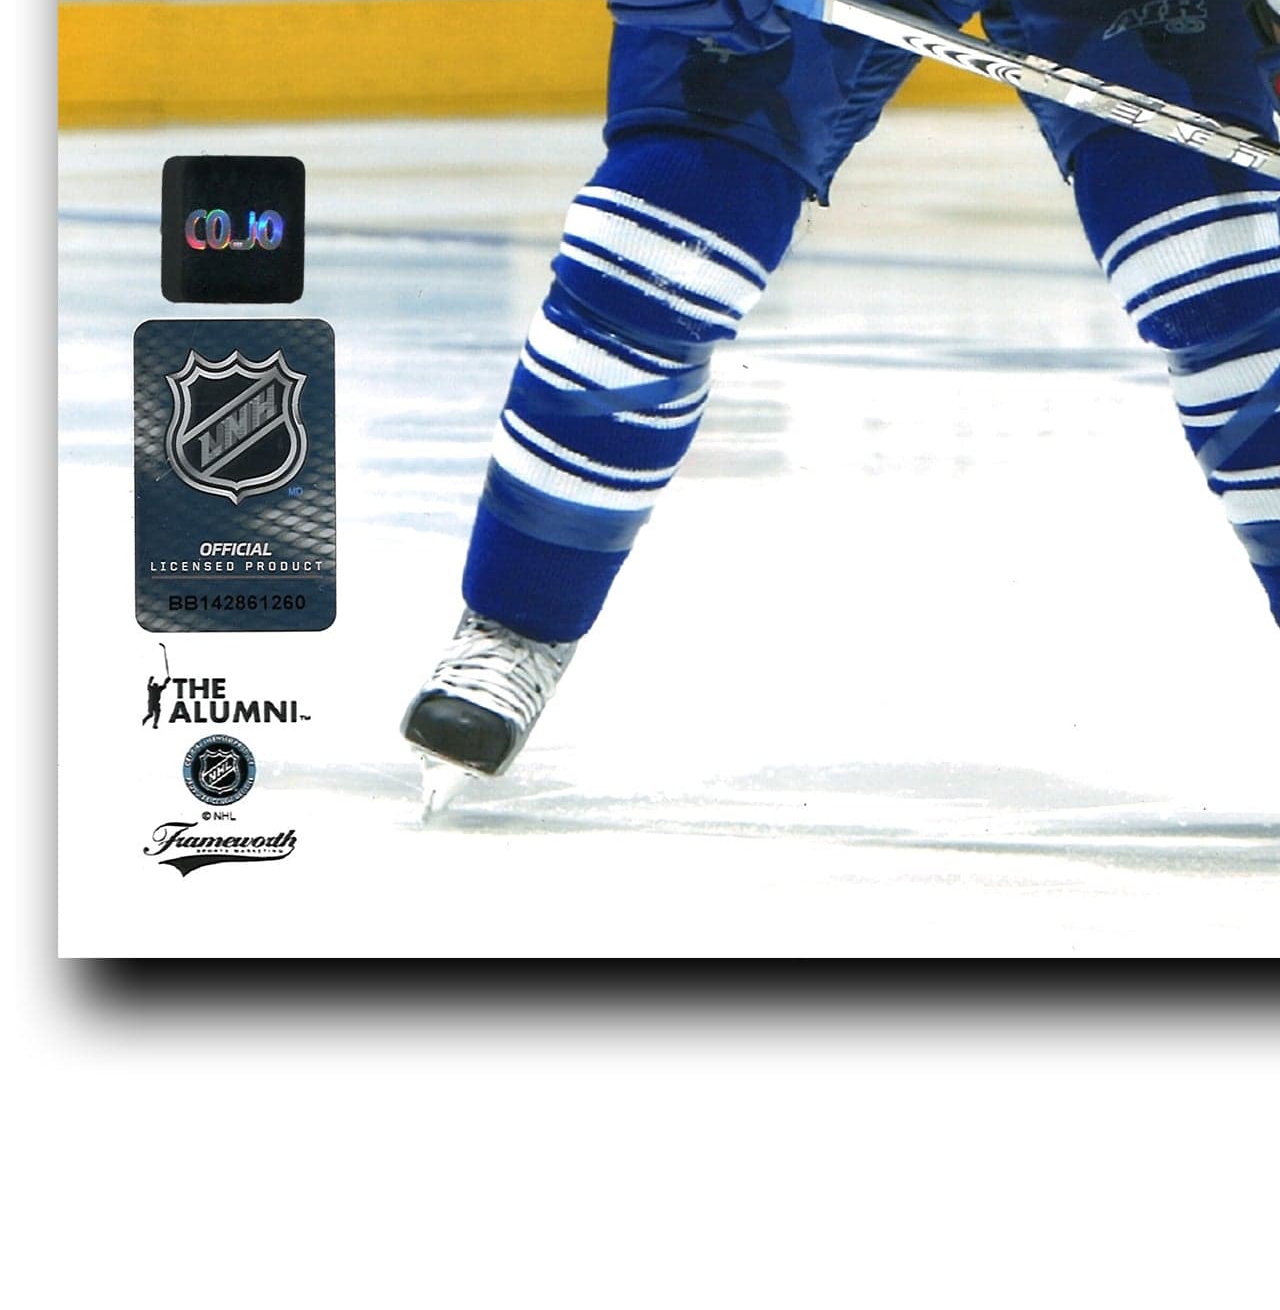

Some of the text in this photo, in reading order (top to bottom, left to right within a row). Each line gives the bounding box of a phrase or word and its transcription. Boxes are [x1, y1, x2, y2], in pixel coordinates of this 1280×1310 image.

[200, 542, 273, 557] OFFICIAL
[150, 561, 323, 572] LICENSED PRODUCT
[168, 595, 306, 611] BB142861260
